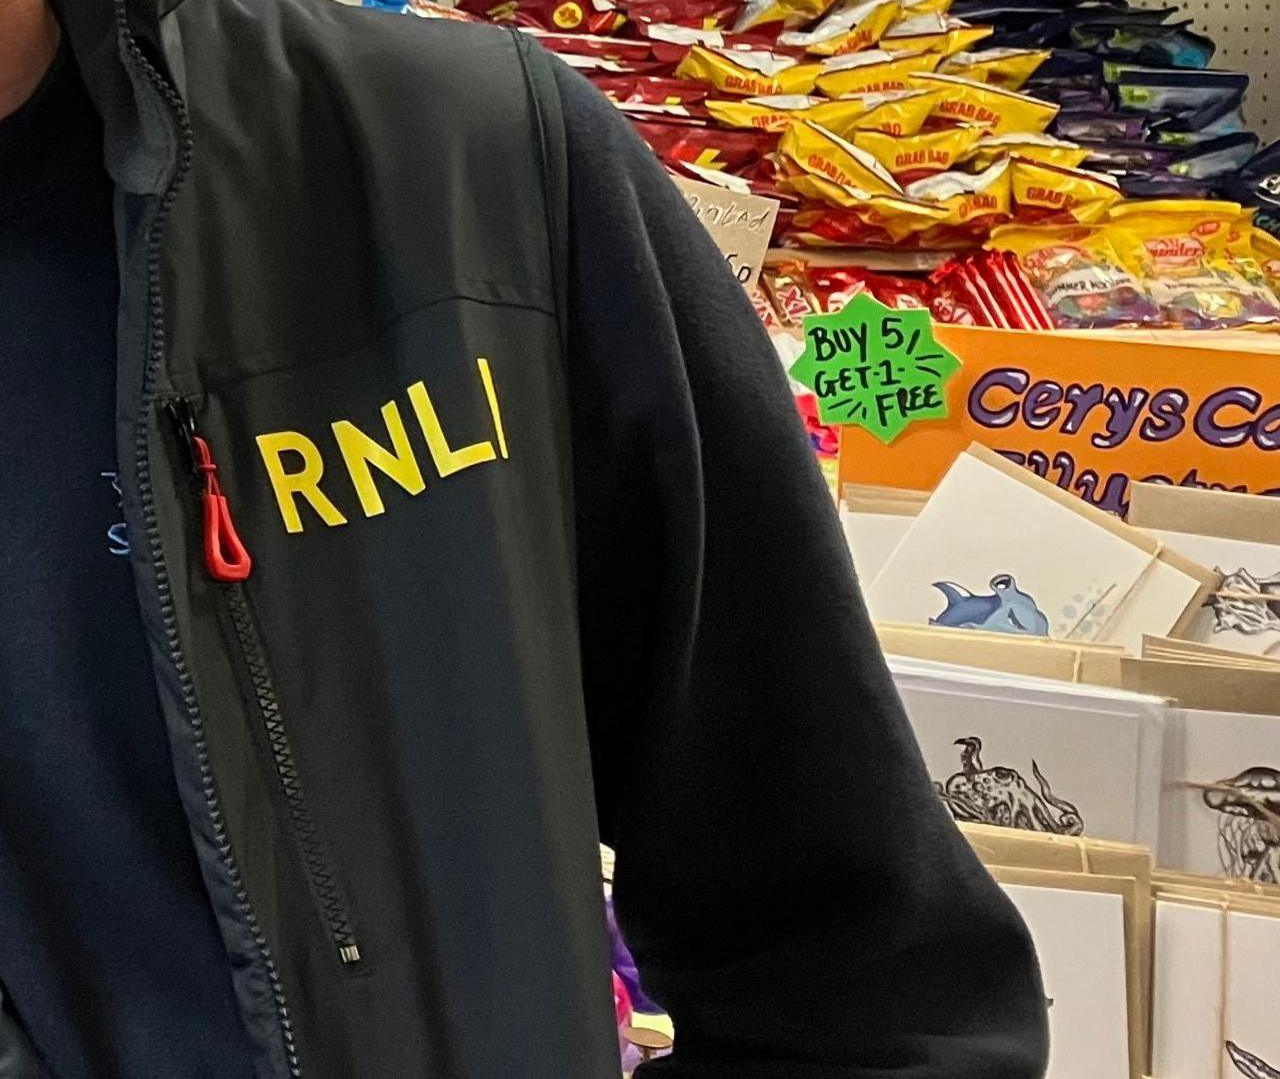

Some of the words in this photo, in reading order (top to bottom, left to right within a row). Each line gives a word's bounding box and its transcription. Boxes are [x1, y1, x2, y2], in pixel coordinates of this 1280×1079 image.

[895, 150, 926, 167] GRAB
[1026, 186, 1062, 204] GRAB
[808, 323, 869, 365] BUY
[875, 384, 943, 428] FREE
[967, 367, 1190, 449] Cerys
[255, 358, 509, 533] RNLI
